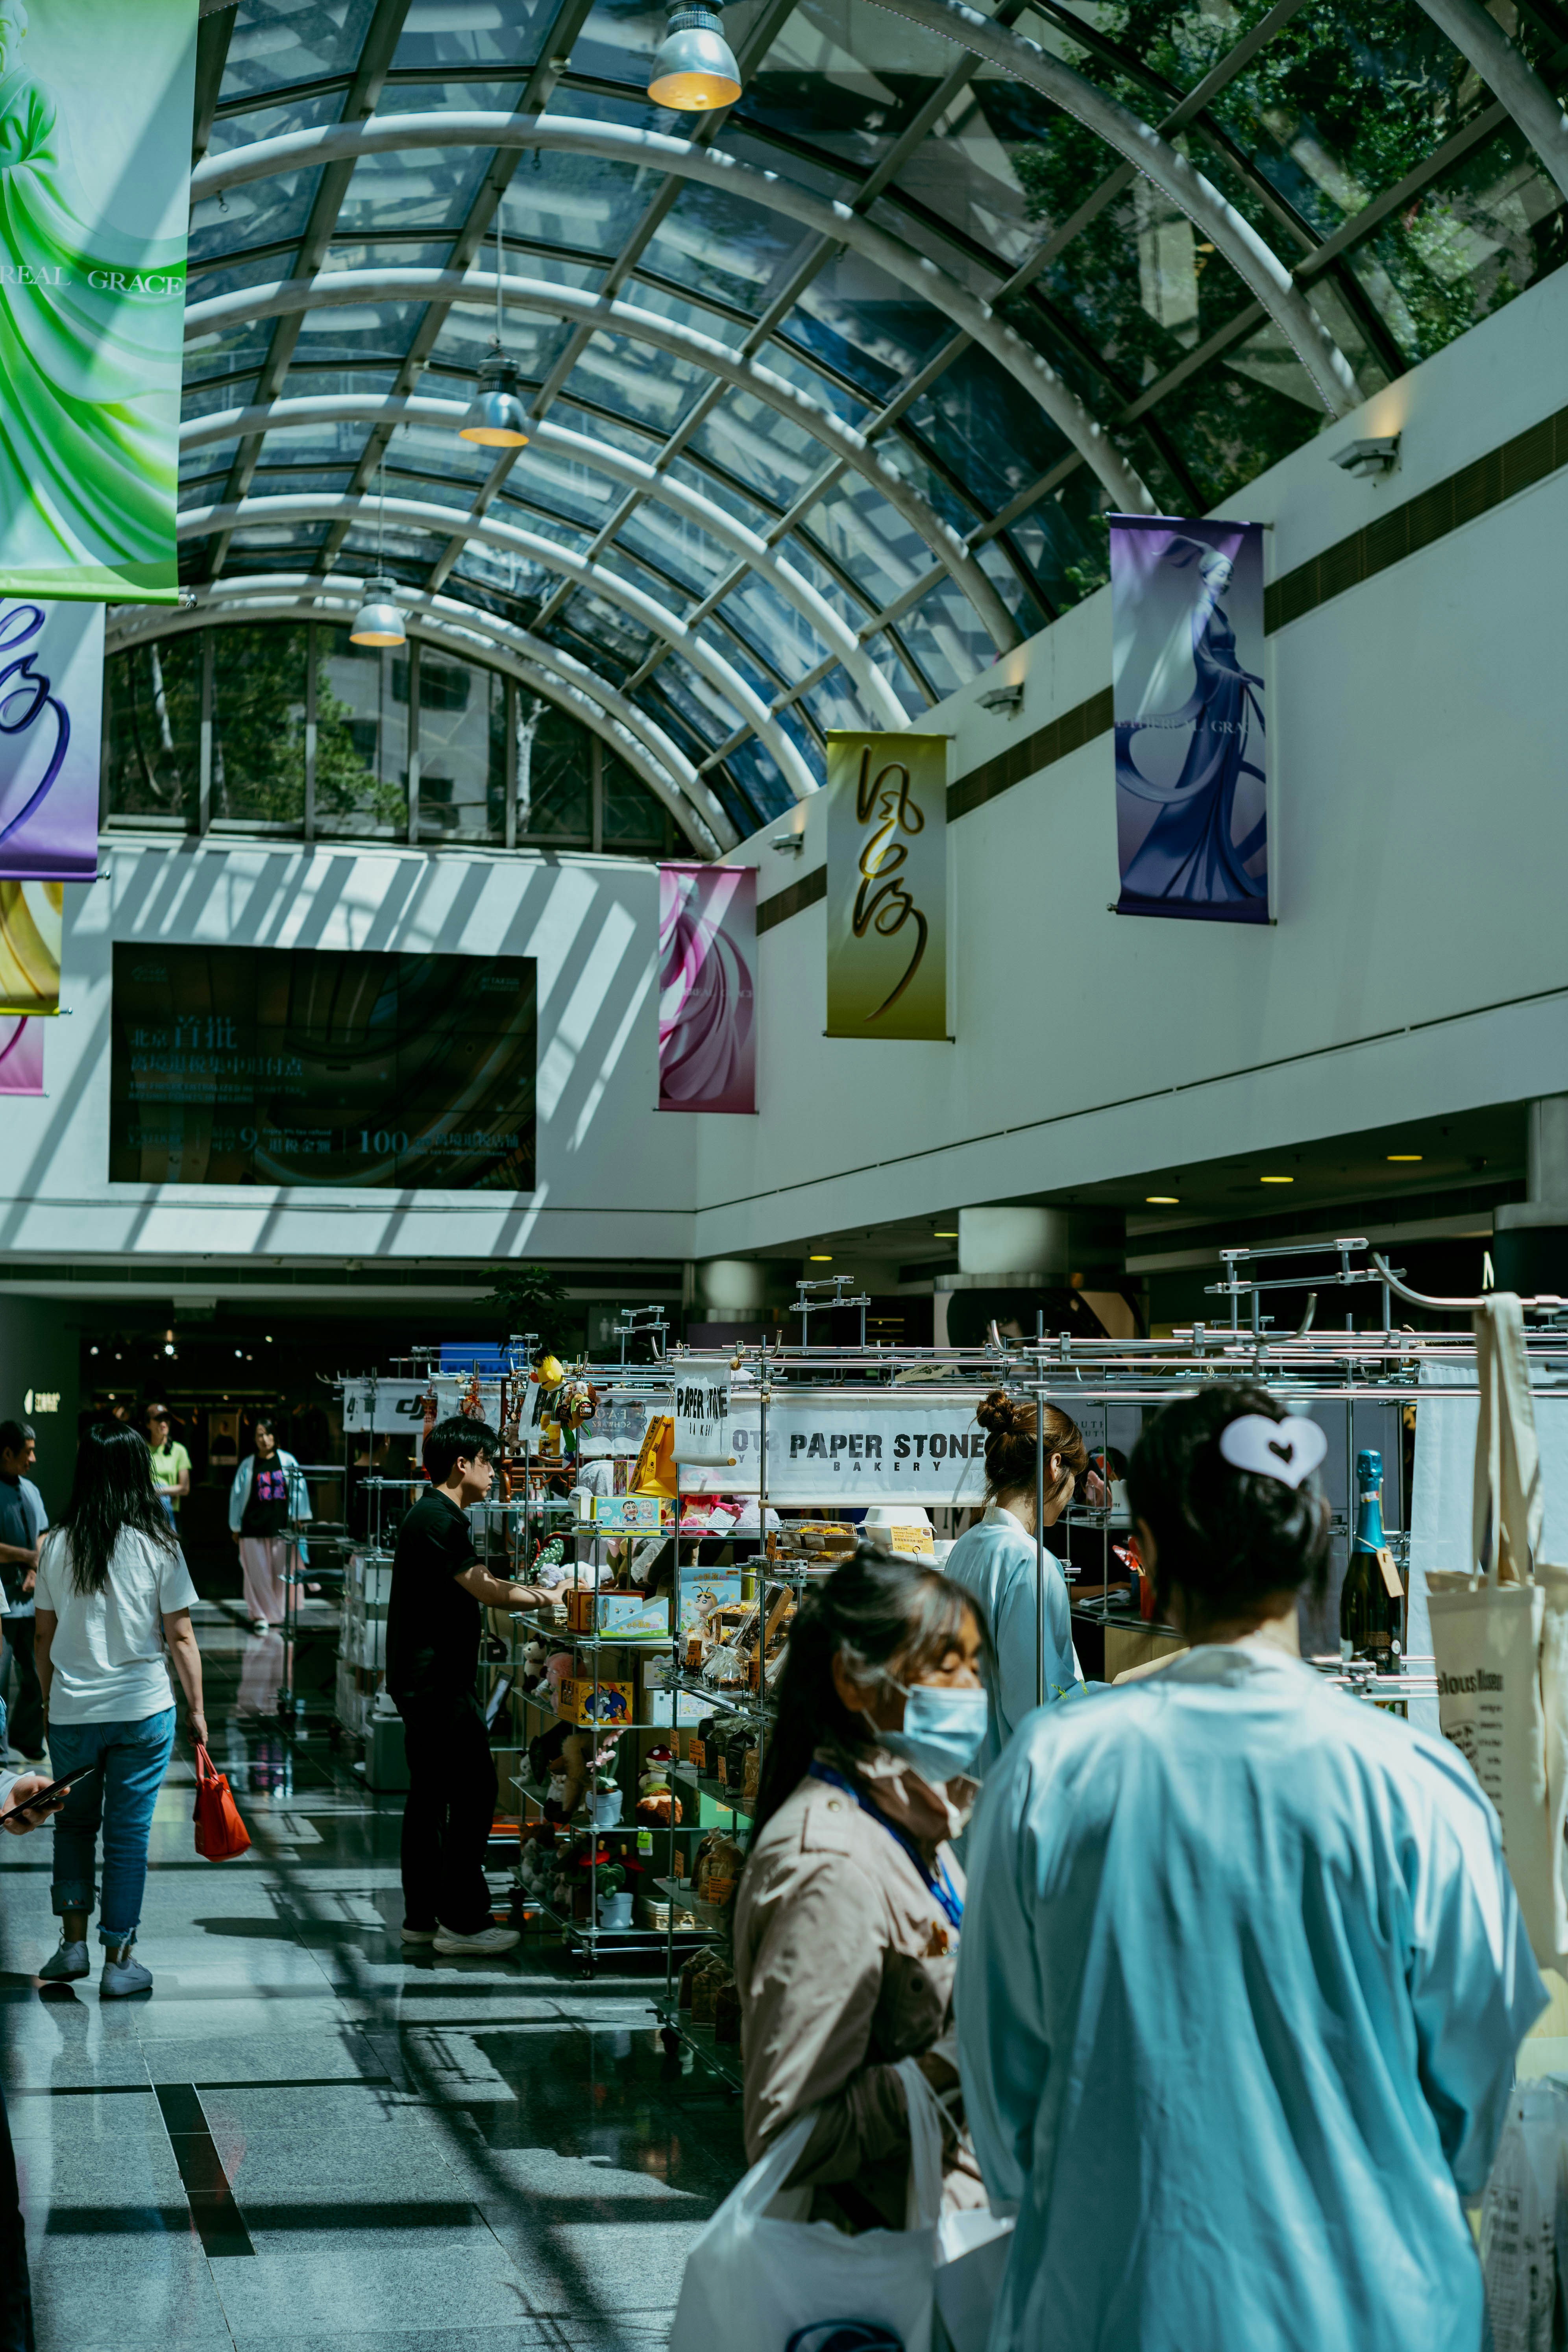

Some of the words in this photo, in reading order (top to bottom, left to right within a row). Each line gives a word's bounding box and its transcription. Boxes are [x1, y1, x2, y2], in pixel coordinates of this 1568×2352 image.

[87, 270, 183, 296] GRACE
[174, 1014, 238, 1050] 首批
[359, 1130, 409, 1156] 100
[677, 1386, 704, 1419] PAPER
[789, 1433, 882, 1459] PAPER
[894, 1433, 986, 1459] STONE
[833, 1462, 942, 1471] BAKERY
